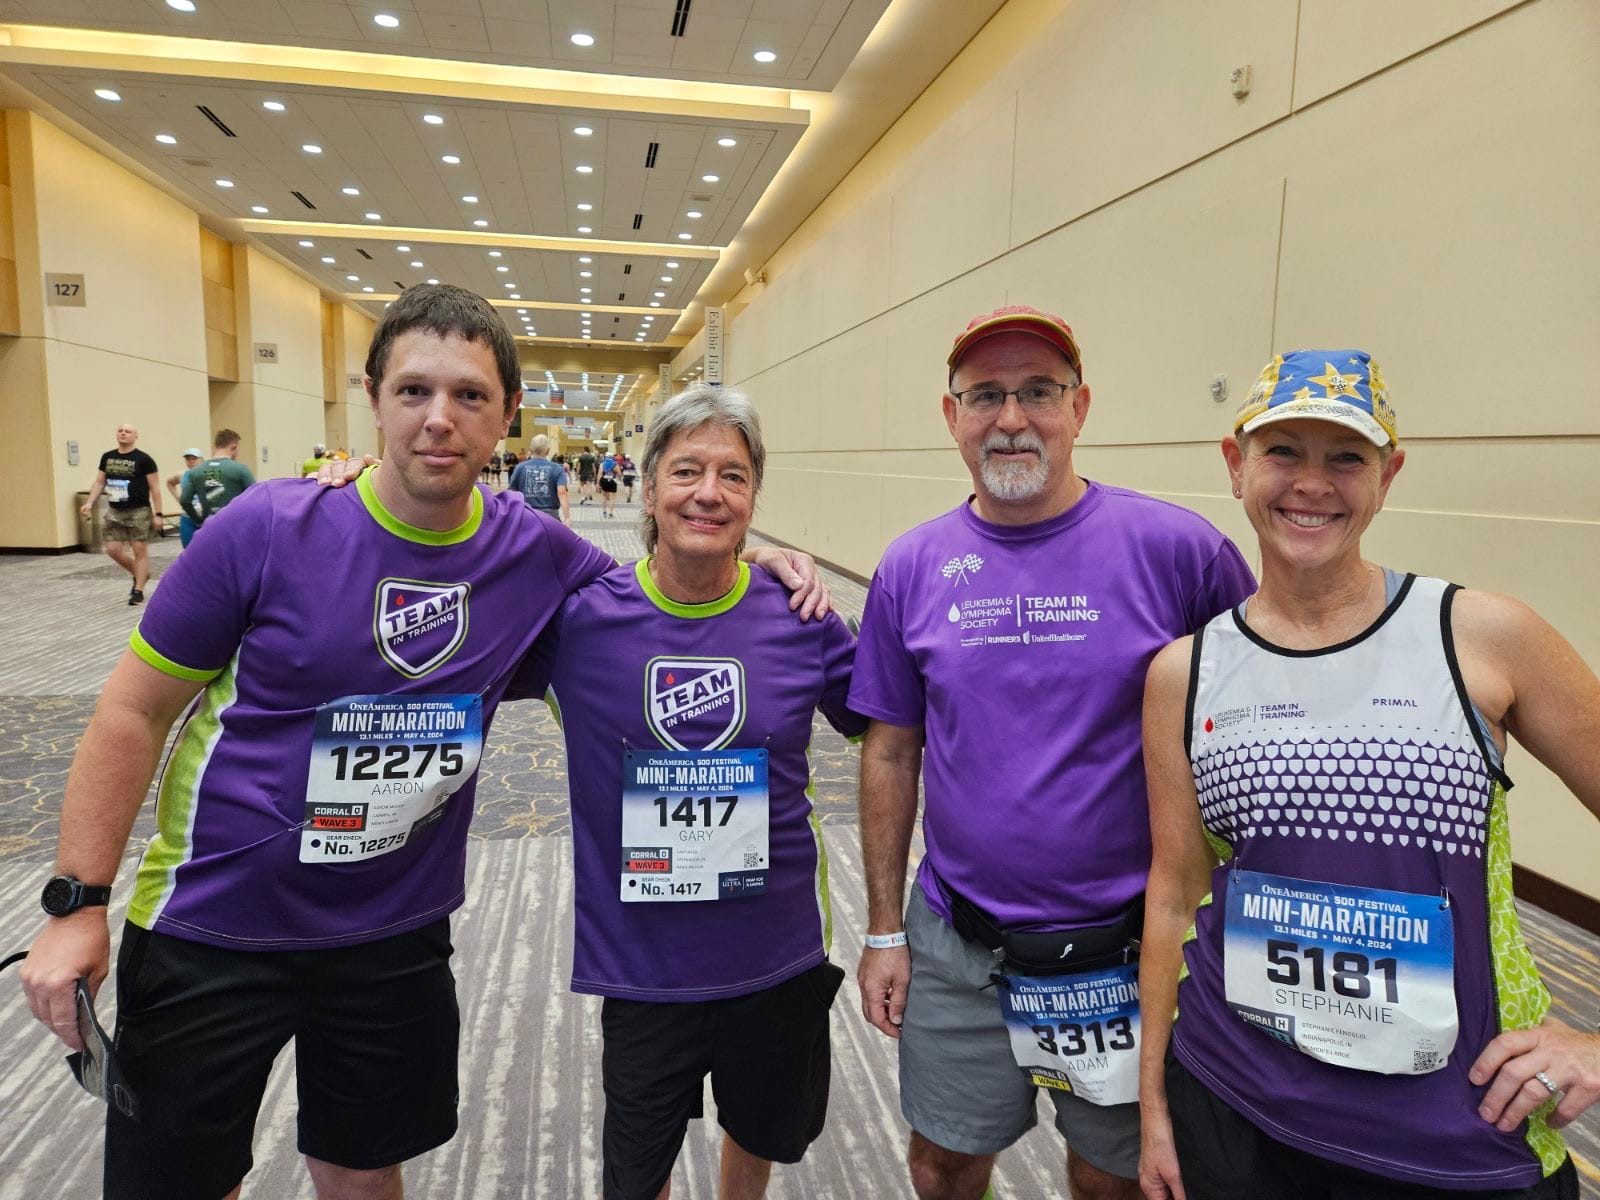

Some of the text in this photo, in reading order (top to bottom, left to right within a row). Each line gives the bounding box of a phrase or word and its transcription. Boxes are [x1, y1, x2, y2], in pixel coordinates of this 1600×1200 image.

[54, 283, 80, 296] 127
[709, 311, 719, 377] Exhibit Hall
[259, 349, 275, 358] 126
[350, 377, 362, 385] 125
[961, 597, 1014, 610] LEUKEMIA &
[1025, 595, 1088, 609] TEAM IN
[385, 590, 460, 633] TEAM
[961, 607, 1012, 620] LYMPHOMA
[1025, 610, 1099, 622] TRAINING
[393, 613, 455, 646] IN TRAINING
[960, 618, 998, 630] SOCIETY
[656, 669, 733, 714] TEAM
[422, 702, 454, 710] FESTIVAL
[1260, 704, 1286, 712] TEAM
[1372, 698, 1418, 707] PRIMAL
[666, 695, 730, 728] IN TRAINING
[1215, 708, 1245, 719] LEUKEMIA
[1215, 712, 1251, 725] LYMPHOMA
[1260, 711, 1306, 720] TRAINING
[331, 711, 466, 732] MINI-MARATHON
[1215, 720, 1241, 730] SOCIETY
[419, 732, 427, 740] 4,
[330, 742, 464, 781] 12275
[636, 766, 754, 784] MINI-MARATHON
[371, 782, 424, 796] AARON
[314, 807, 350, 816] CORRAL
[654, 796, 739, 827] 1417
[319, 818, 347, 827] WAVE
[679, 830, 714, 841] GARY
[324, 831, 406, 855] No. 12275
[641, 883, 702, 895] No. 1417
[1334, 896, 1355, 906] 500
[1358, 899, 1408, 914] FESTIVAL
[1243, 893, 1428, 944] MINI-MARATHON
[1274, 925, 1392, 950] 13.1 MILES MAY 4, 2024
[1267, 939, 1399, 1004] 5181
[1074, 982, 1088, 990] 500
[1090, 976, 1122, 988] FESTIVAL
[1010, 982, 1140, 1012] MINI-MARATHON
[1275, 988, 1394, 1024] STEPHANIE
[1278, 1019, 1286, 1028] H
[1033, 1017, 1135, 1056] 3313
[1069, 1057, 1110, 1072] ADAM
